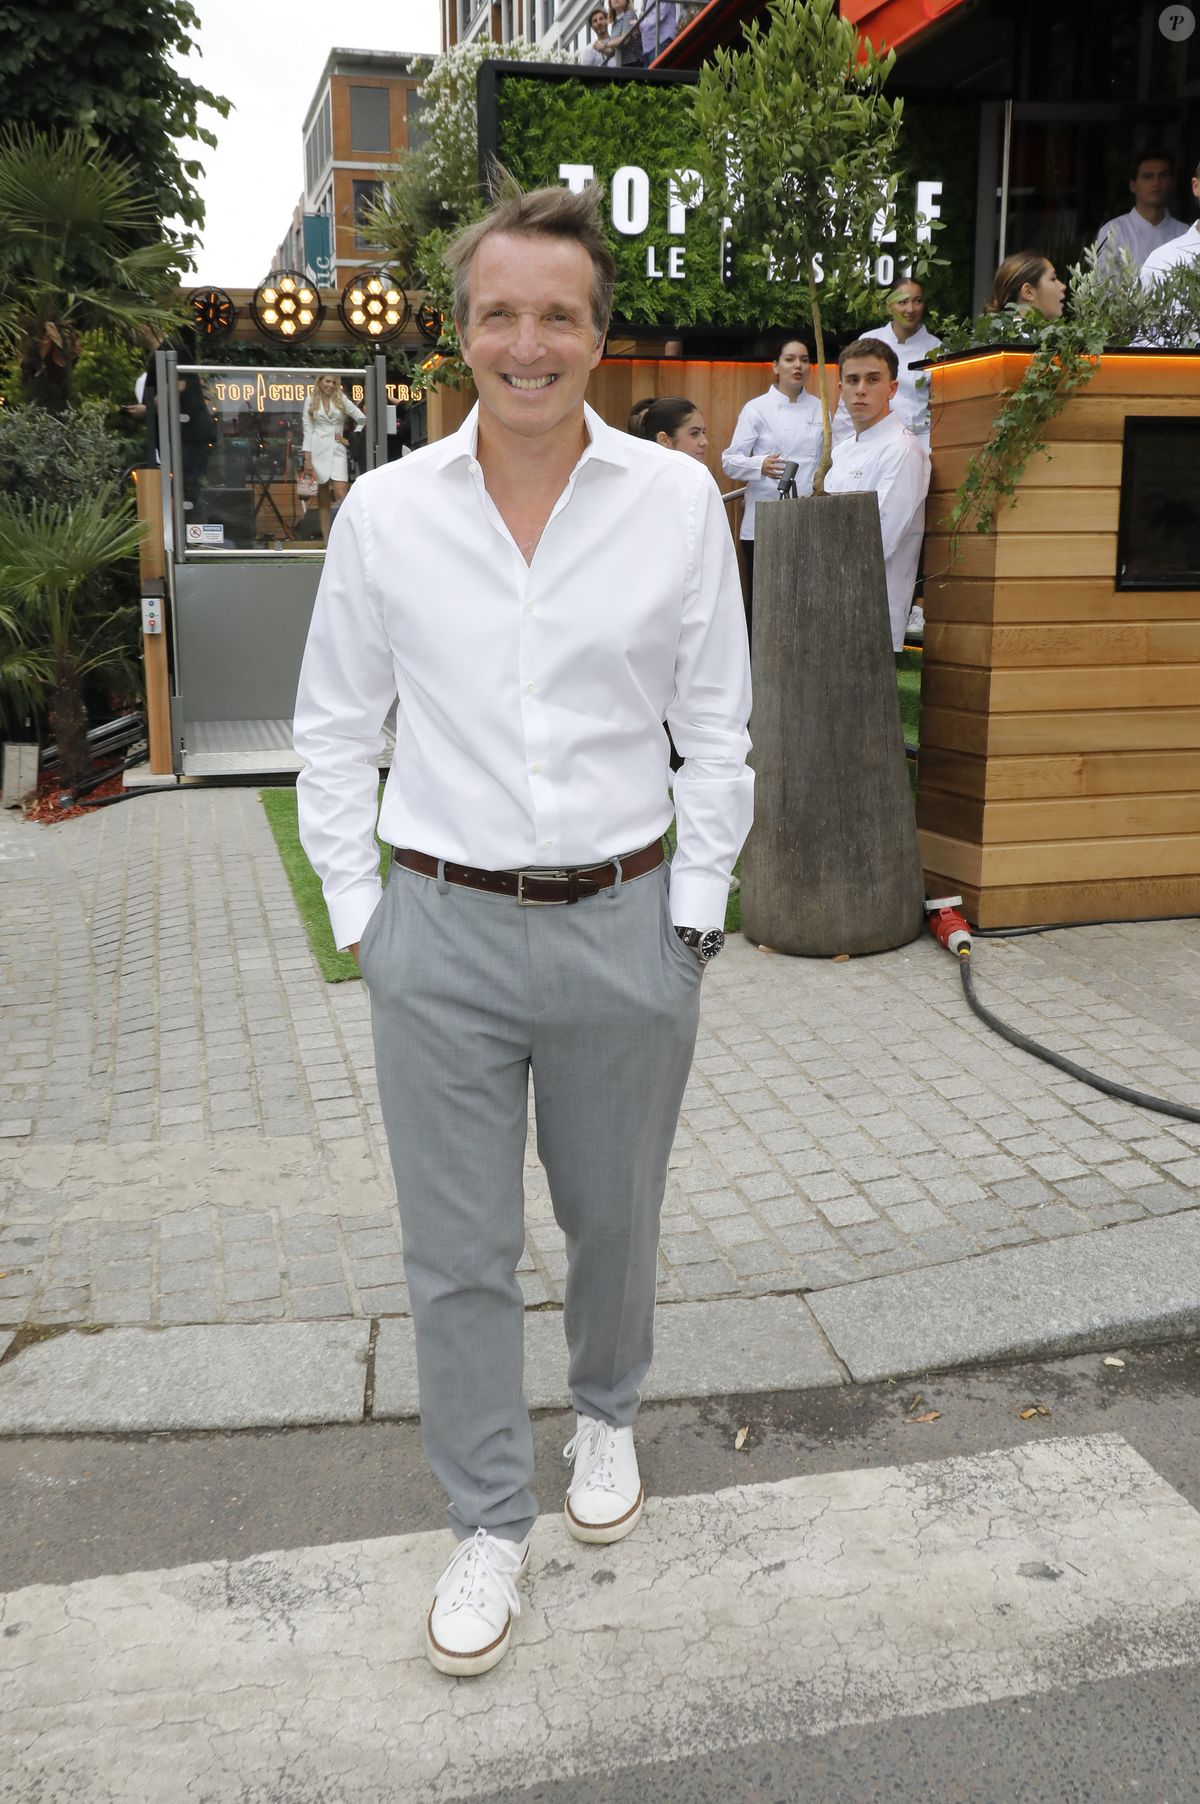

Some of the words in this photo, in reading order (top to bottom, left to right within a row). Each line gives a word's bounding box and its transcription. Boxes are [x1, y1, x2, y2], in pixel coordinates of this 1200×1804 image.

[558, 163, 704, 235] TOP
[771, 172, 943, 243] EF
[646, 245, 686, 279] LE
[215, 384, 254, 401] TOP
